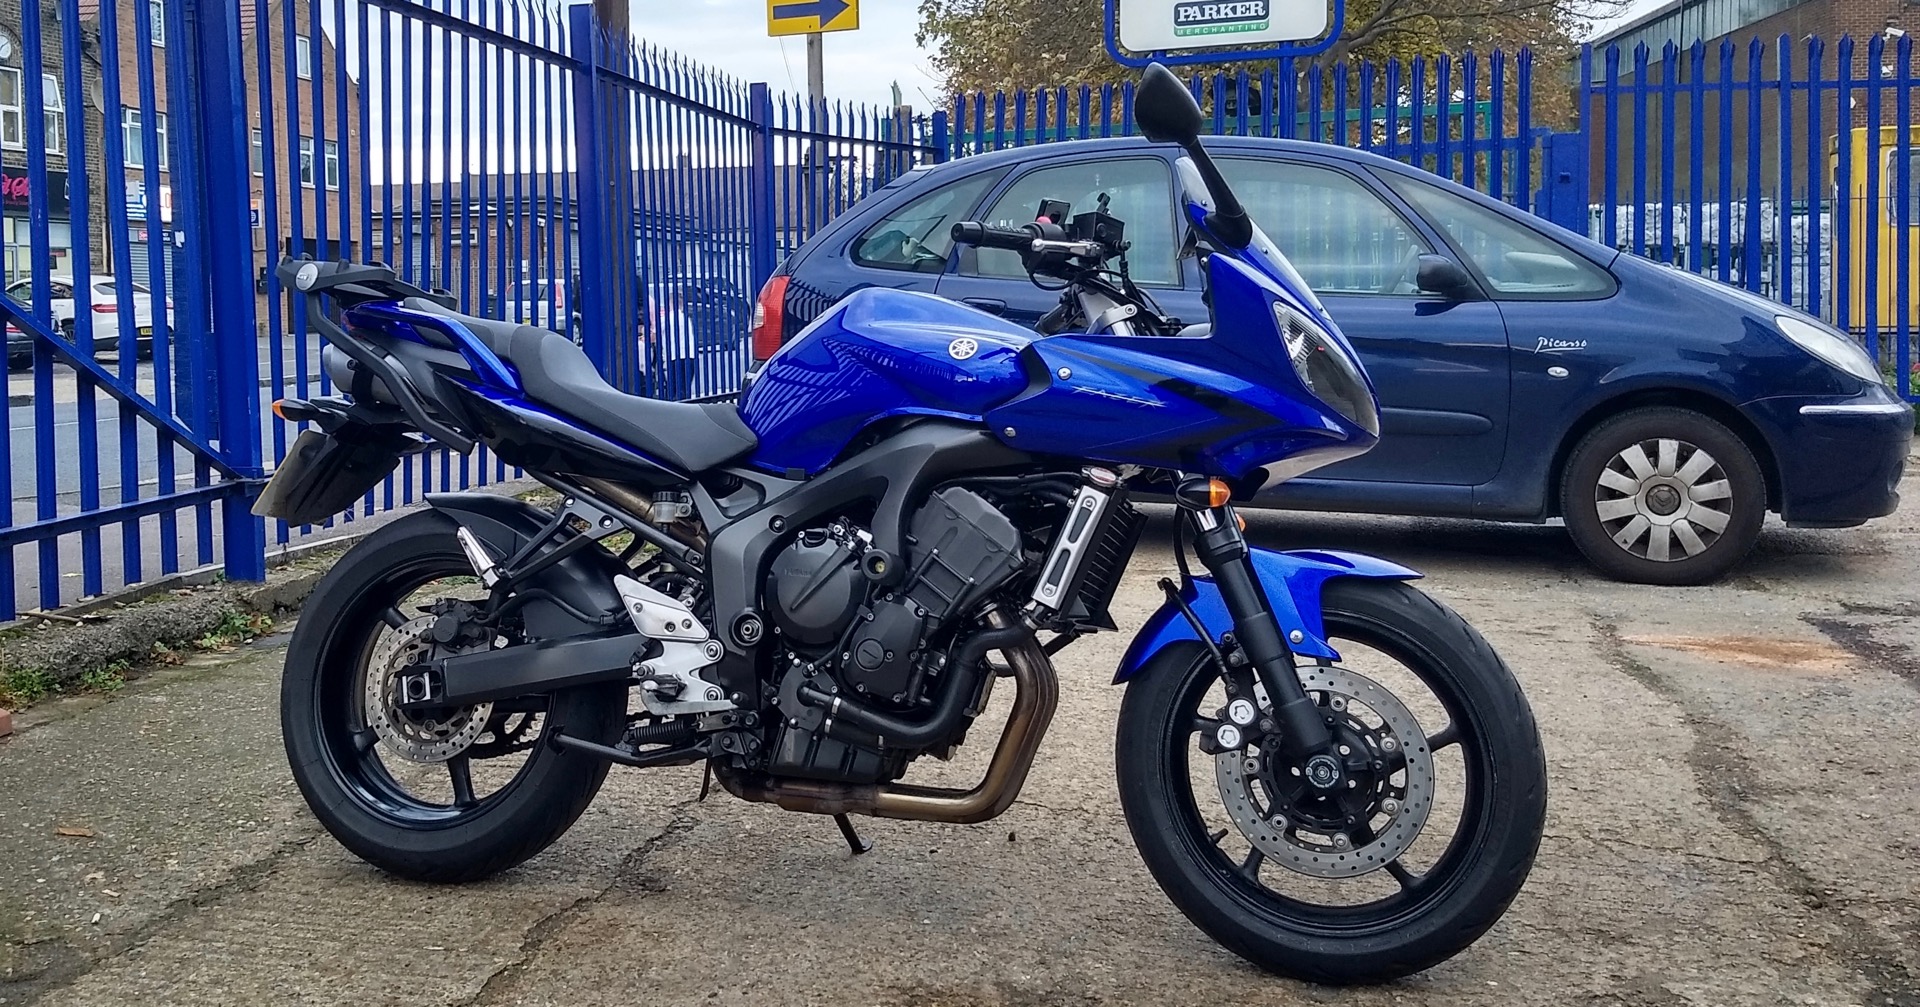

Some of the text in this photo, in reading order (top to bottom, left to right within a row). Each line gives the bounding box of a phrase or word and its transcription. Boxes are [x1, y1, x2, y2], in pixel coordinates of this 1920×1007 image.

[1177, 1, 1266, 22] PARKER
[1177, 23, 1266, 35] MERCHANTING
[1534, 336, 1587, 354] Picasso
